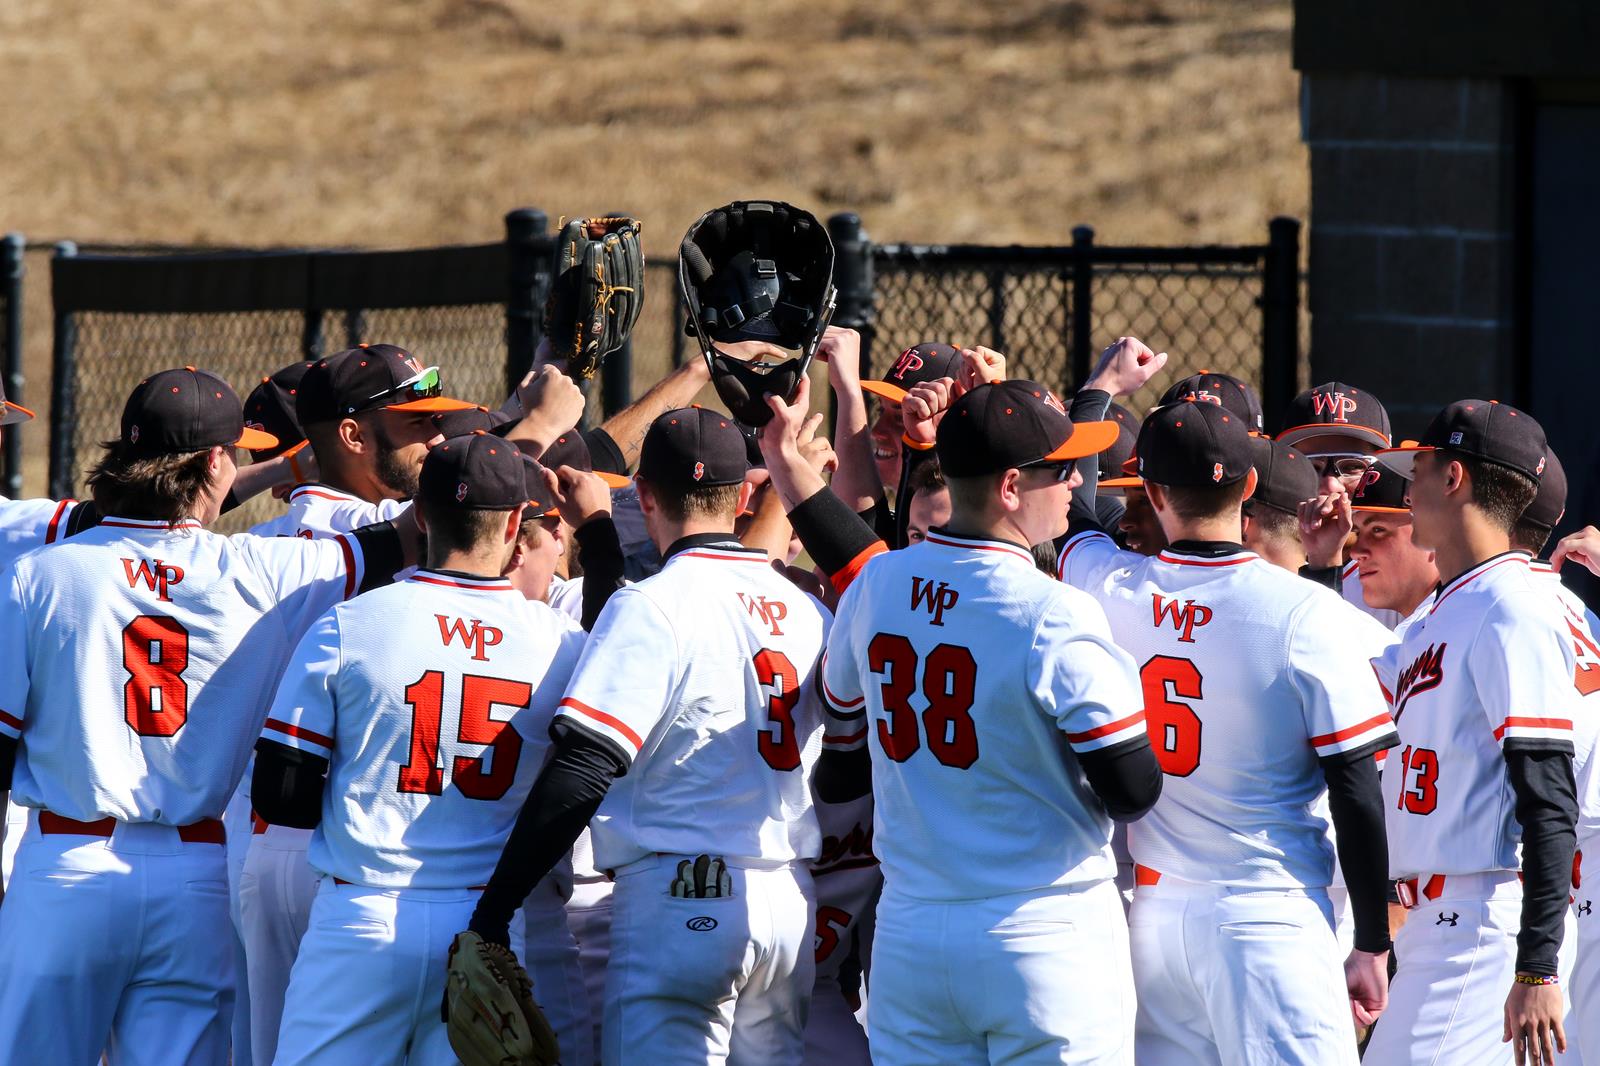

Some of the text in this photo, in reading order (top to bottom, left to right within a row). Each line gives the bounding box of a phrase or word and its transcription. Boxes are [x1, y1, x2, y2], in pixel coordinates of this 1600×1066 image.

[1311, 391, 1357, 423] WP
[121, 557, 185, 602] WP
[911, 576, 959, 627] WP
[434, 613, 504, 662] WP
[736, 592, 787, 636] WP
[1151, 592, 1213, 643] WP
[122, 614, 189, 738] 8
[867, 631, 980, 771] 38
[396, 669, 533, 801] 15
[752, 647, 802, 772] 3
[1140, 654, 1203, 778] 6
[1397, 744, 1440, 816] 13
